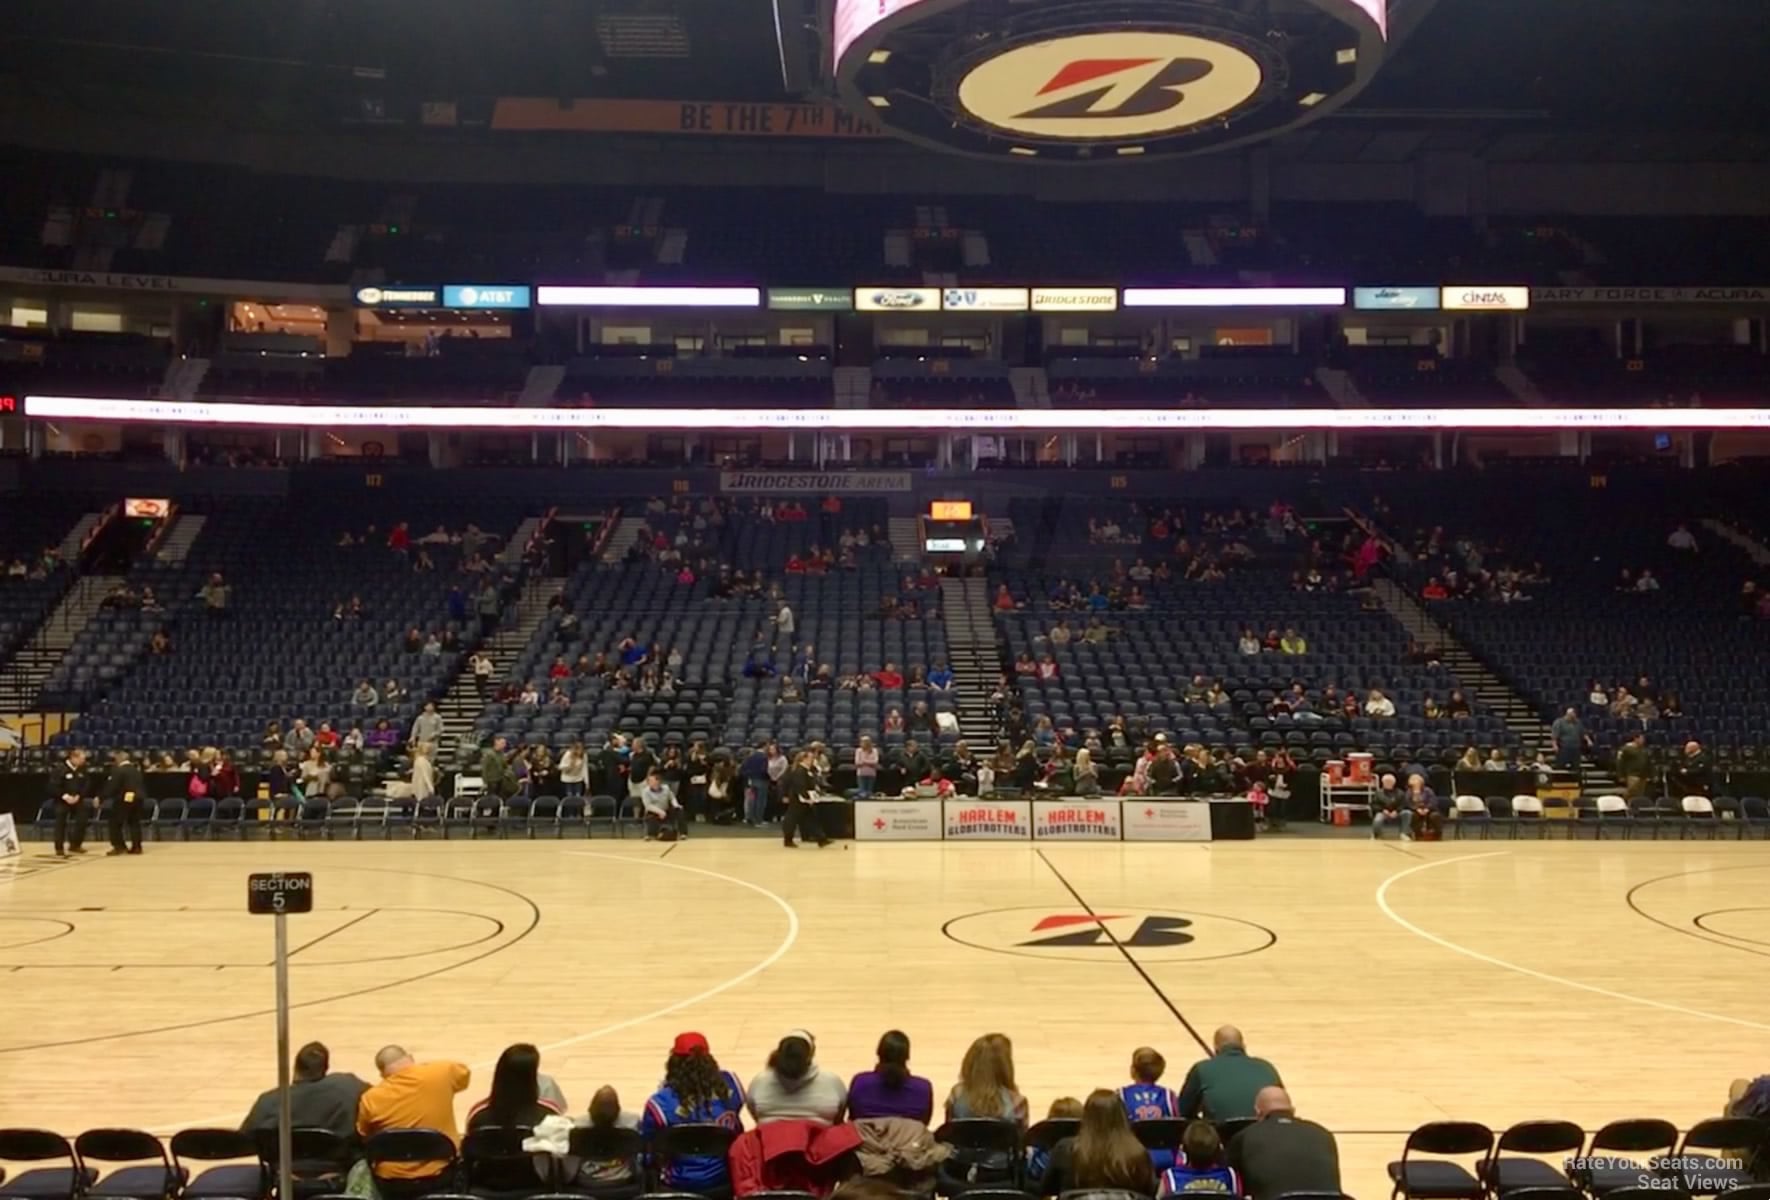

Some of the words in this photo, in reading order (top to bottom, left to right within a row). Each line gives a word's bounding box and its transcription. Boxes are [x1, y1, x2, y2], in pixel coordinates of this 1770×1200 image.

[680, 104, 713, 131] BE
[725, 105, 774, 132] THE
[106, 274, 179, 289] LEVEL
[480, 290, 515, 303] AT&T
[880, 294, 914, 307] Ford
[1035, 295, 1113, 305] BRIDGESTONE
[1595, 289, 1671, 302] FORCE
[1695, 290, 1765, 302] ACURA
[727, 473, 851, 489] BRIDGESTONE
[855, 474, 905, 488] ARENA
[959, 809, 1016, 824] HARLEM
[1048, 809, 1105, 824] HARLEM
[947, 824, 1027, 836] GLOBETROTTERS
[1037, 824, 1117, 836] GLOBETROTTERS
[251, 879, 310, 891] SECTION
[272, 892, 286, 909] 5
